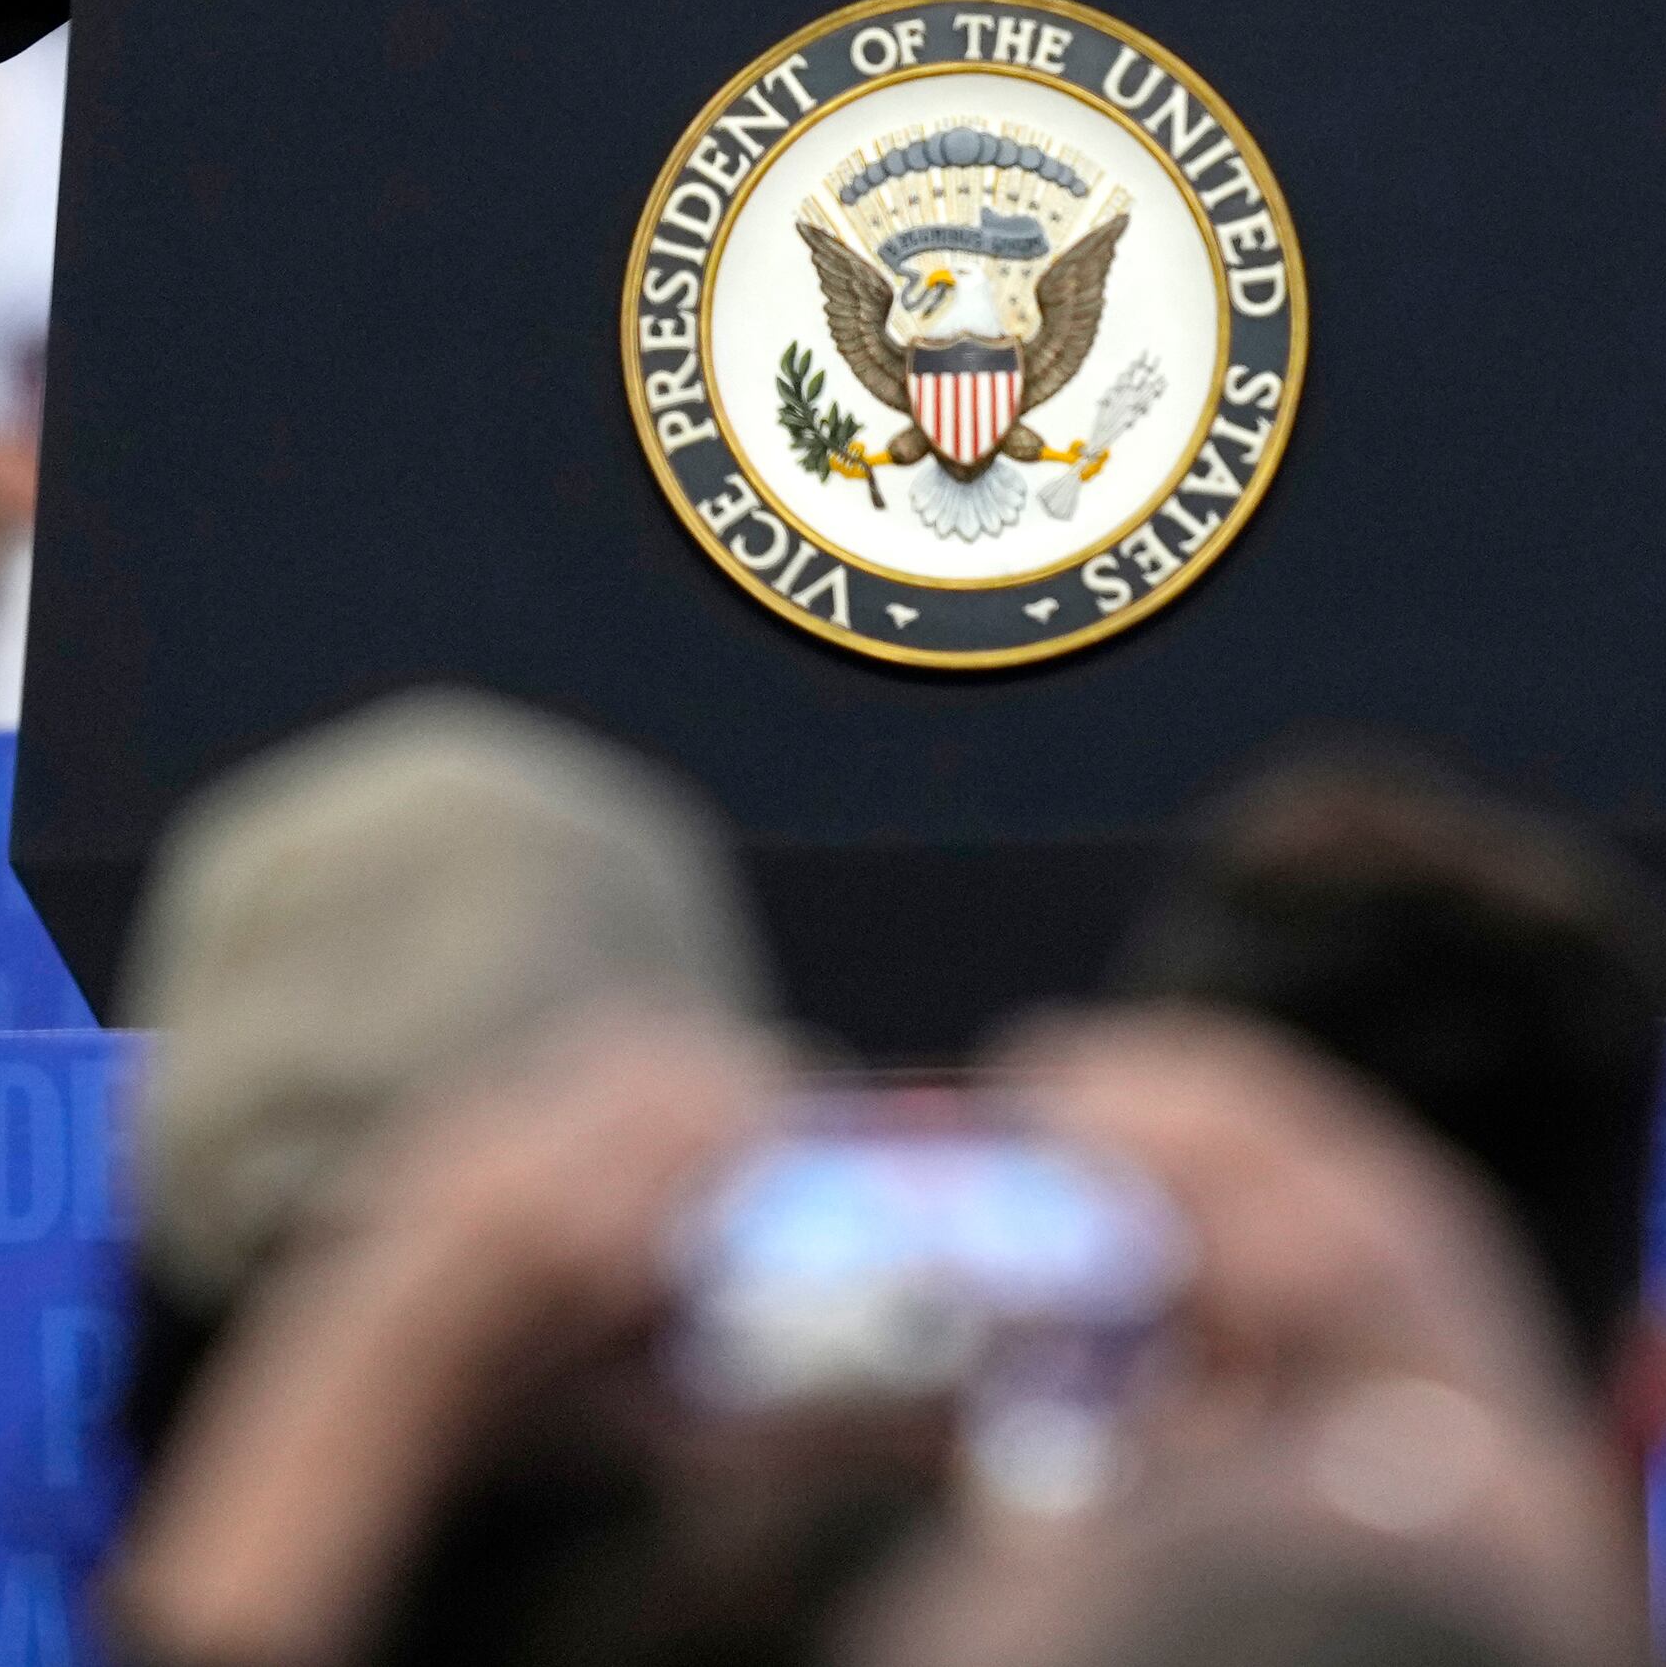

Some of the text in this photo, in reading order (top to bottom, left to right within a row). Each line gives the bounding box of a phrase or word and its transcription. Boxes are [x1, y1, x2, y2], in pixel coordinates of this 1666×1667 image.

[851, 19, 927, 77] OF
[953, 13, 1073, 75] THE
[638, 52, 821, 455] PRESIDENT
[1102, 45, 1288, 320] UNITED
[697, 472, 854, 632] VICE
[1080, 362, 1284, 617] STATES
